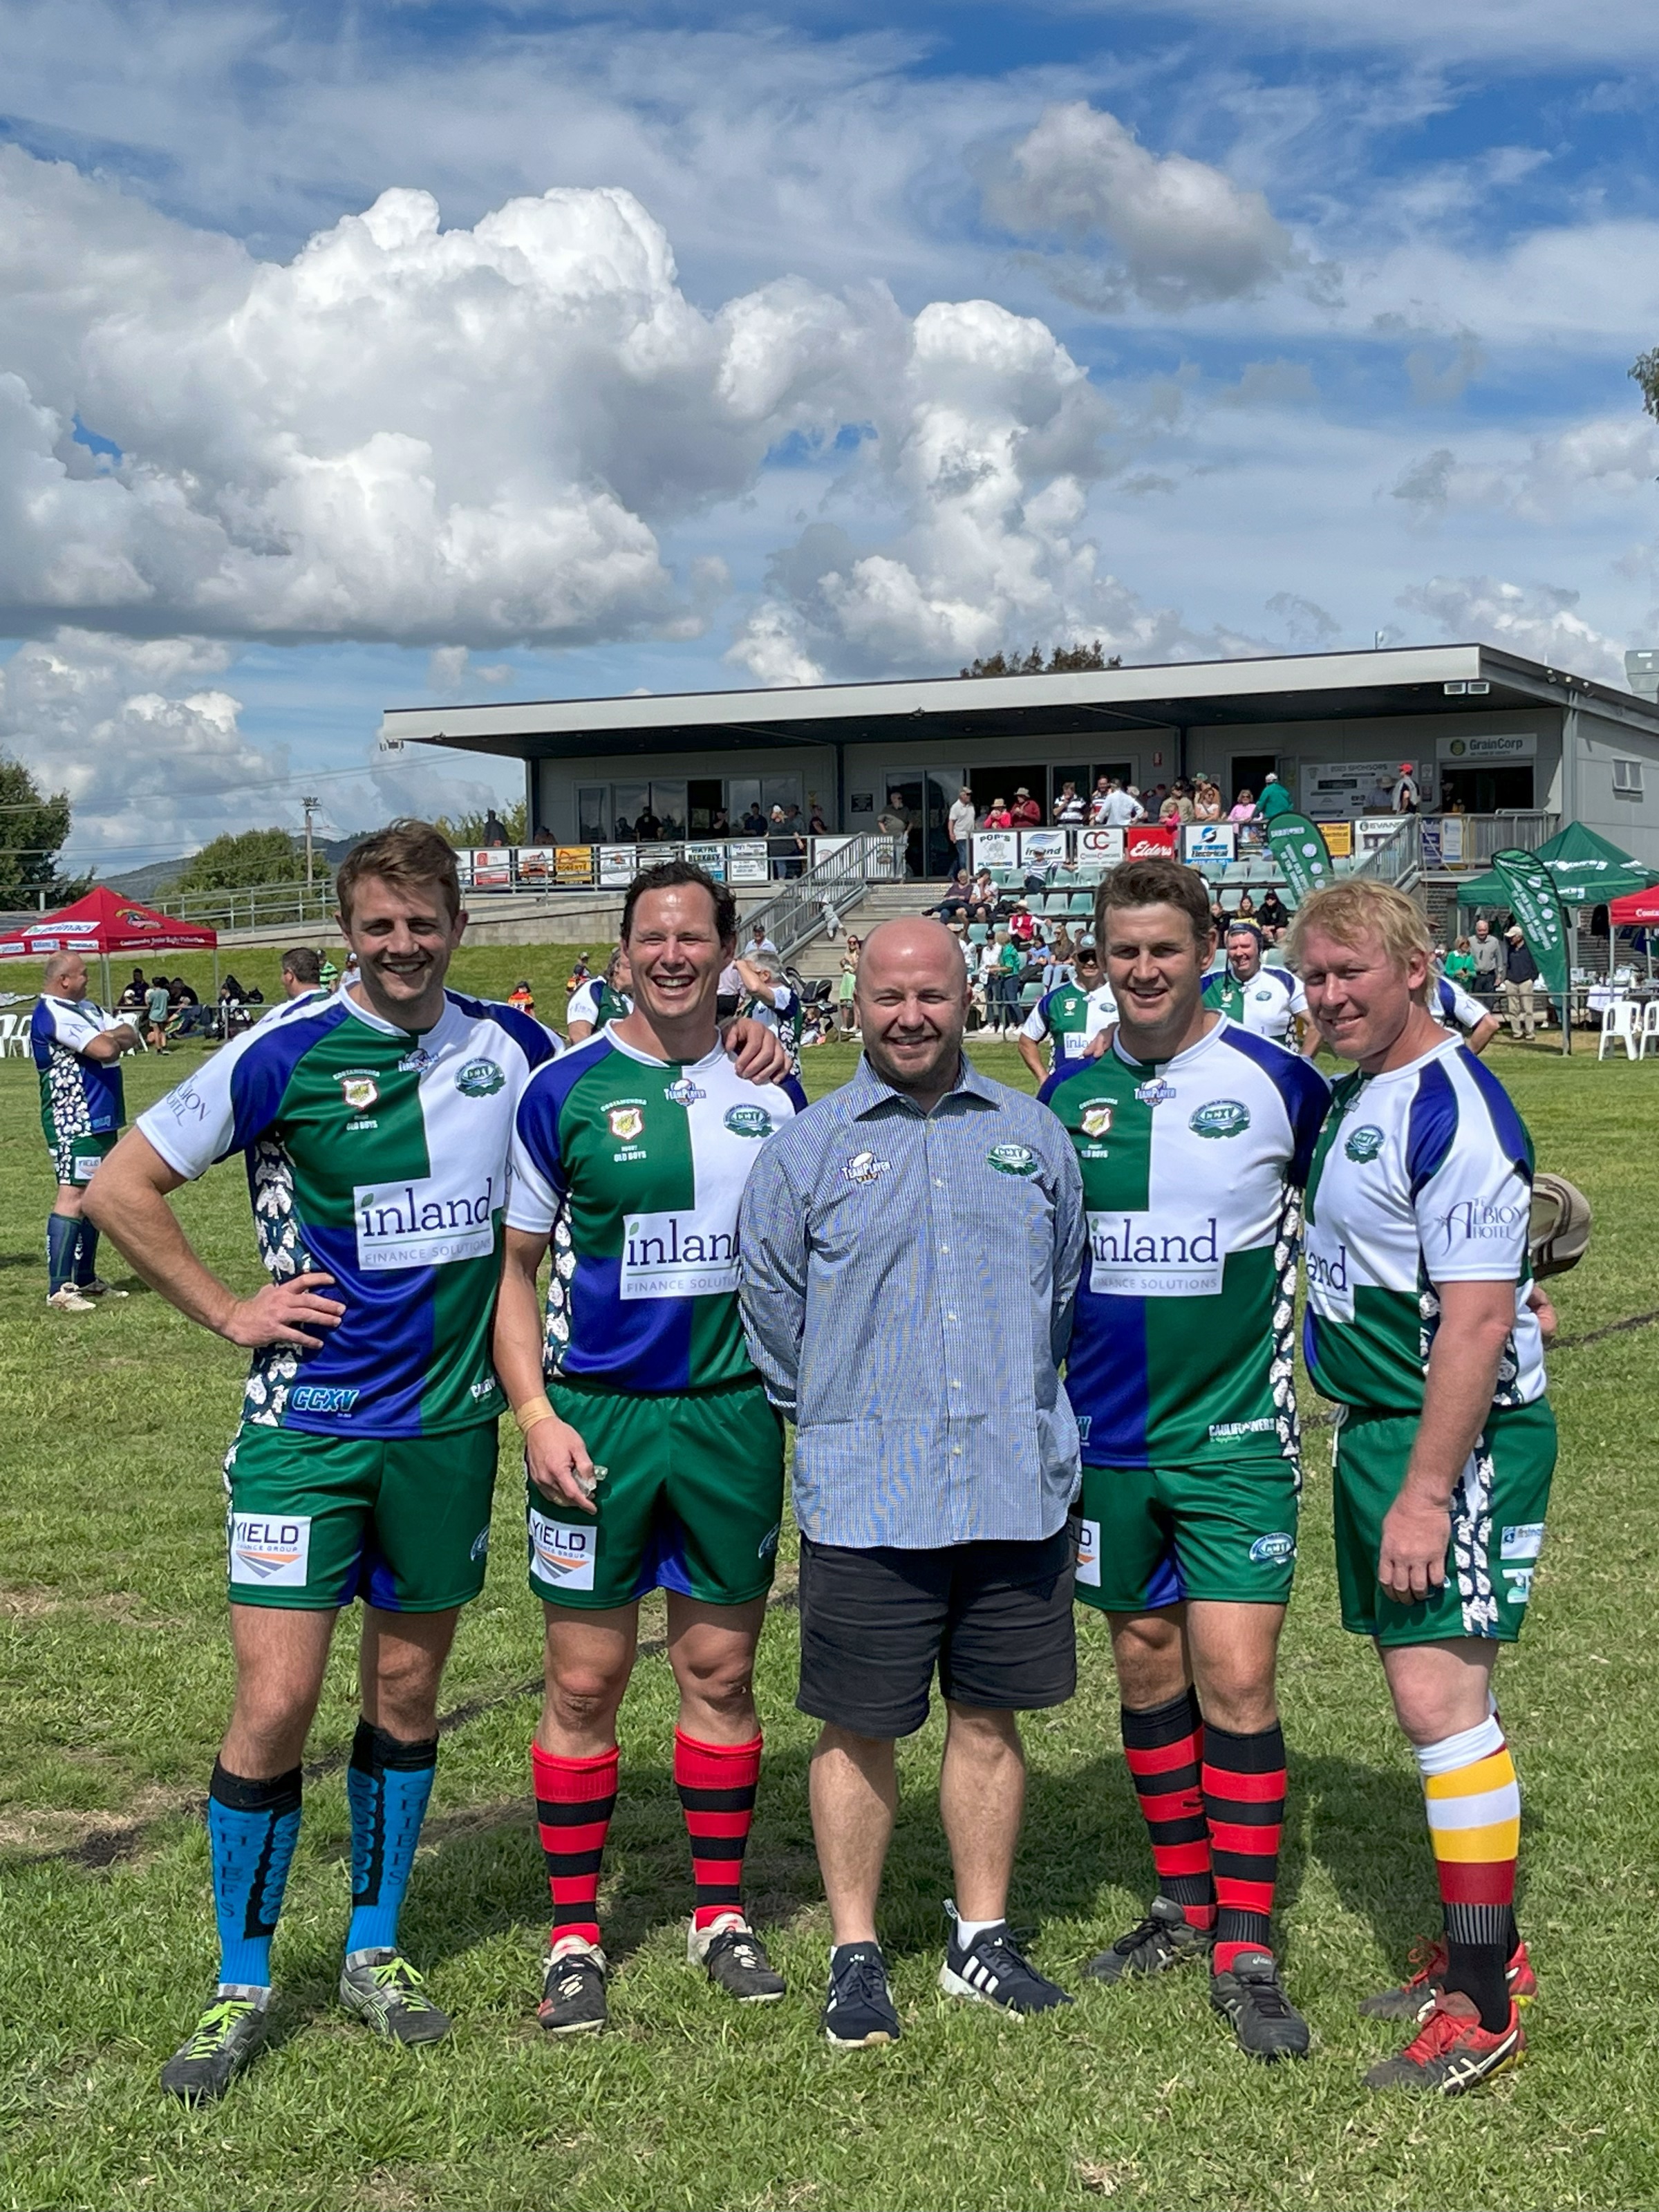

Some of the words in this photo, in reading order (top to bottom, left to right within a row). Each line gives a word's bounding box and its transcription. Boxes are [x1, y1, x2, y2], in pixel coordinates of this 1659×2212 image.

[1470, 738, 1523, 750] GrainCorp
[1130, 841, 1172, 857] Elders
[1066, 1035, 1089, 1049] inla
[614, 1153, 627, 1162] OLD
[628, 1151, 646, 1161] BOYS
[361, 1177, 492, 1237] inland
[1092, 1218, 1218, 1263] inland
[1472, 1225, 1517, 1241] HOTEL
[365, 1248, 427, 1264] FINANCE
[432, 1238, 491, 1258] SOLUTIONS
[627, 1280, 684, 1293] FINANCE
[1141, 1279, 1217, 1291] SOLUTIONS
[237, 1522, 299, 1544] YIELD
[532, 1517, 586, 1551] YIELD
[218, 1817, 250, 1919] CHIEFS
